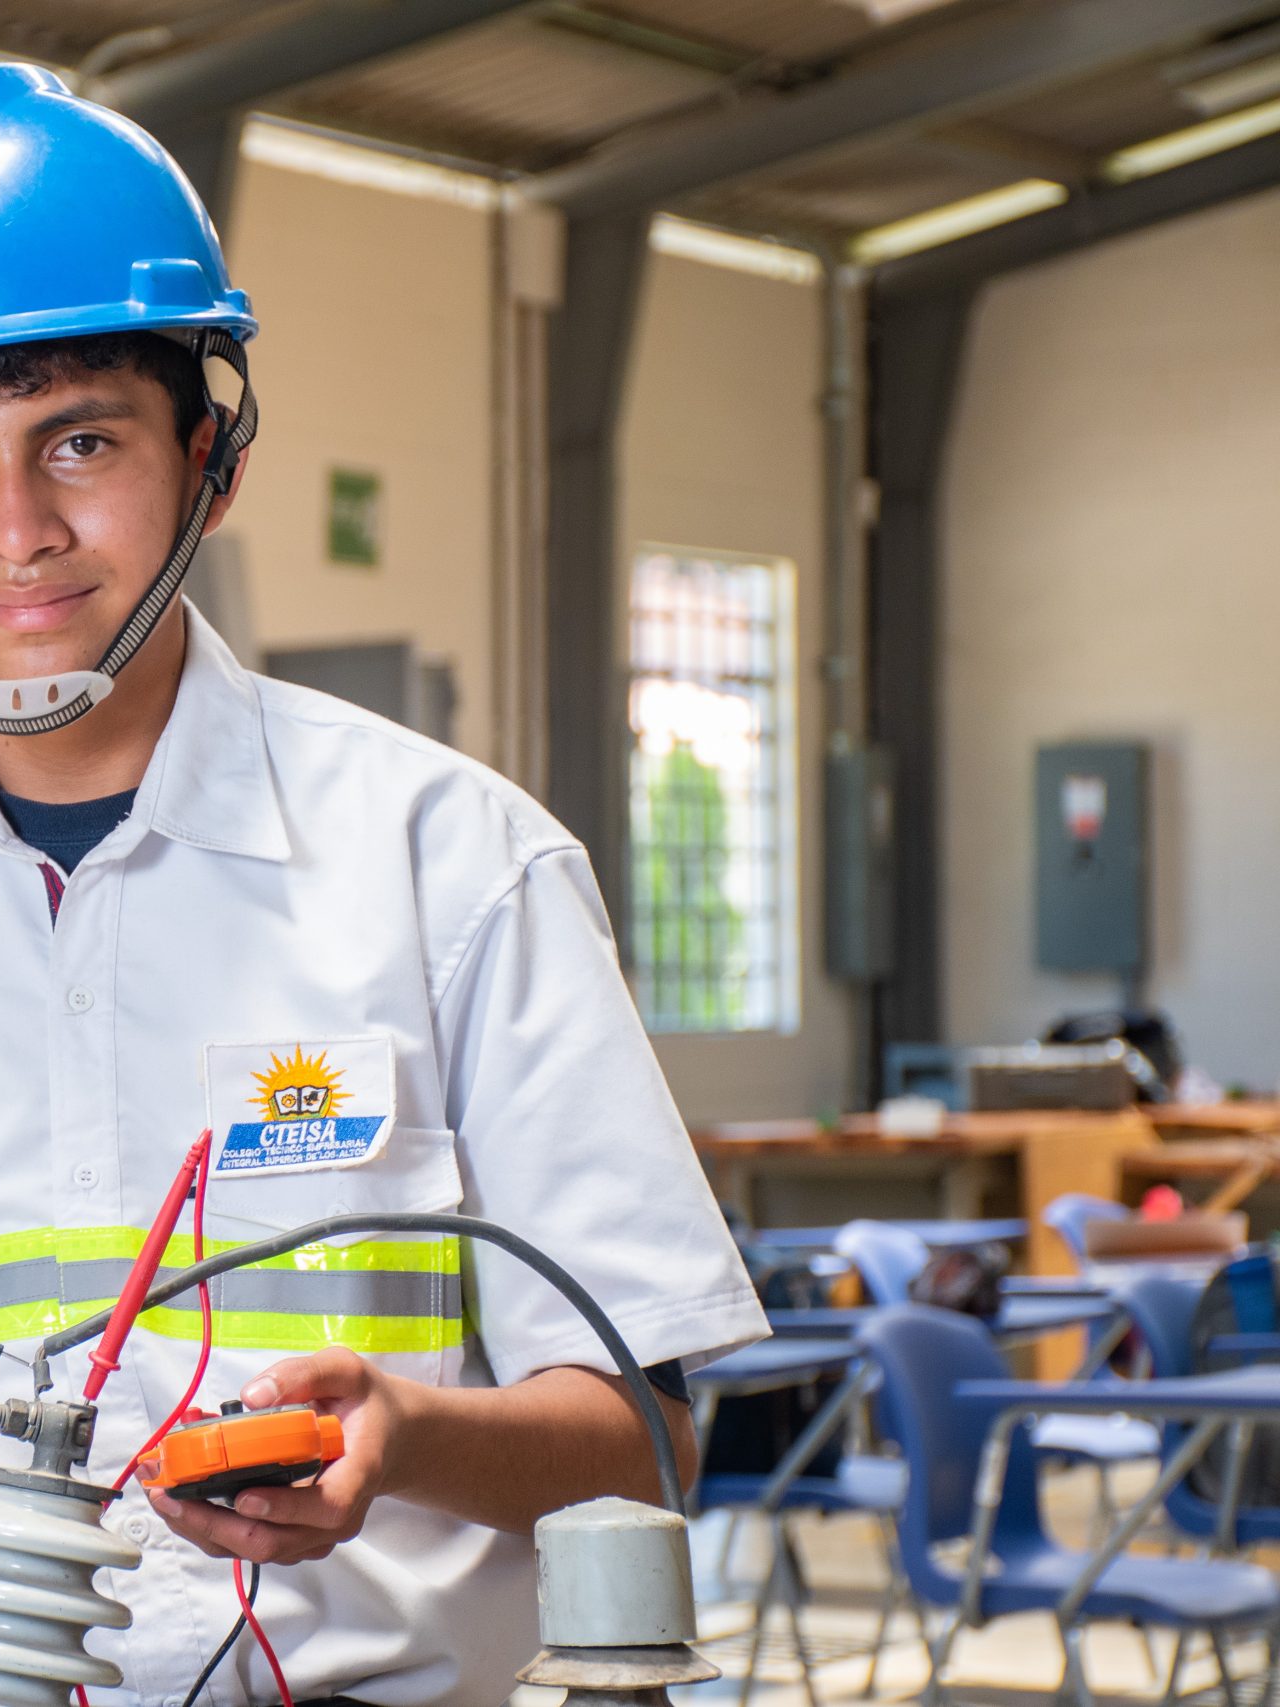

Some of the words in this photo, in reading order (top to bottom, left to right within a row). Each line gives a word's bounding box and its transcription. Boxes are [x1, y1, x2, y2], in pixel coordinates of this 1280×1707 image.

[260, 1120, 336, 1147] CTEISA
[222, 1157, 262, 1169] INTEGRAL
[264, 1154, 303, 1166] SUPERIOR
[306, 1152, 317, 1161] DE
[319, 1150, 336, 1160] LOS
[339, 1147, 367, 1158] ALTOS
[223, 1148, 261, 1158] COLEGIO
